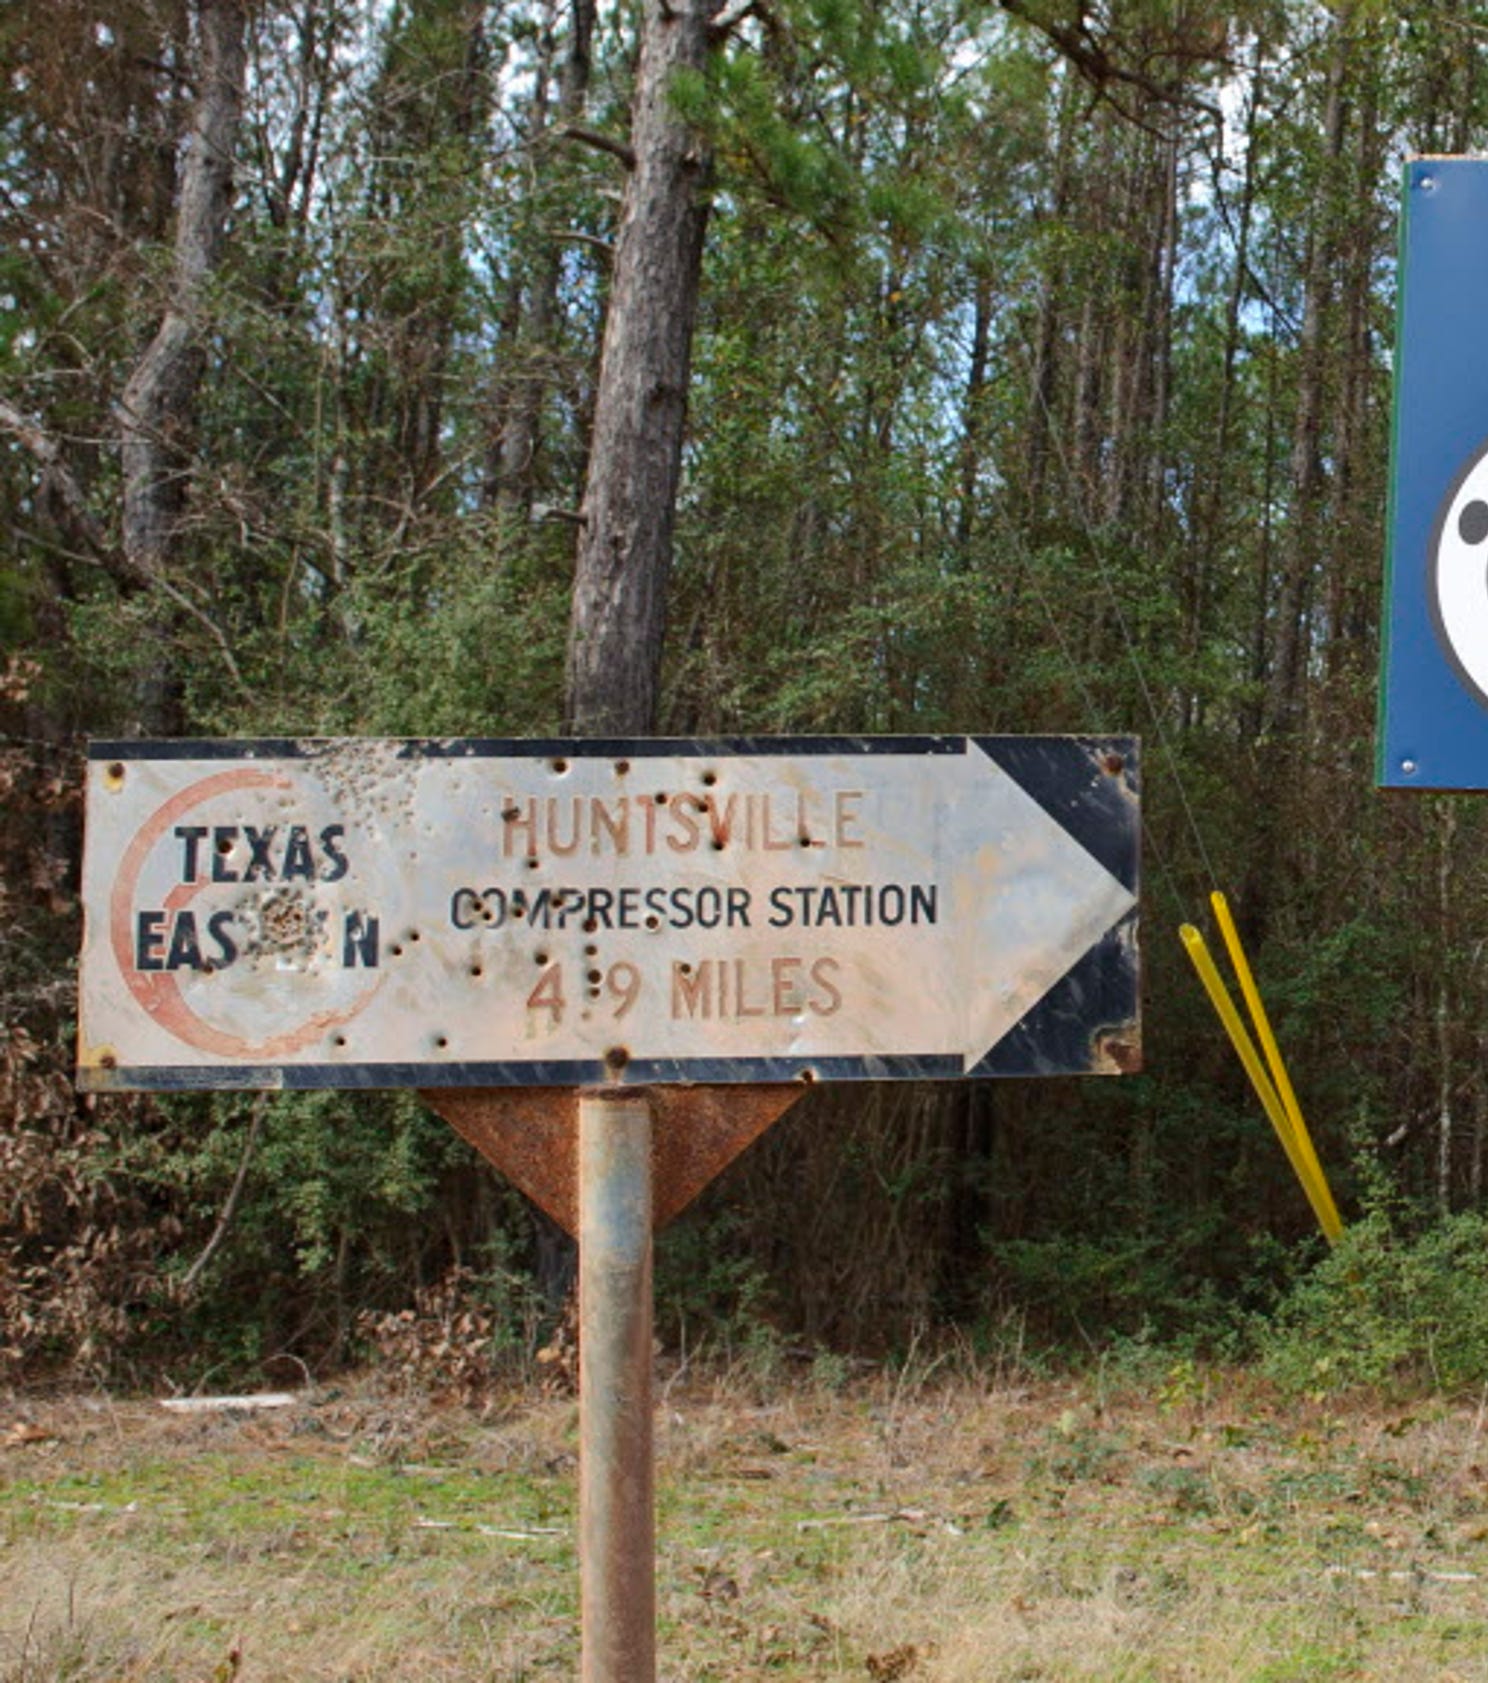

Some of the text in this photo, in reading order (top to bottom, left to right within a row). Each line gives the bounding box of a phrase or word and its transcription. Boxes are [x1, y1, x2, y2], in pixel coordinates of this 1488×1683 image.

[174, 824, 349, 884] TEXAS
[502, 790, 866, 859] HUNTSVILLE
[450, 883, 938, 930] COMPRESSOR STATION
[136, 910, 379, 971] EASN
[526, 957, 843, 1025] 4.9 MILES
